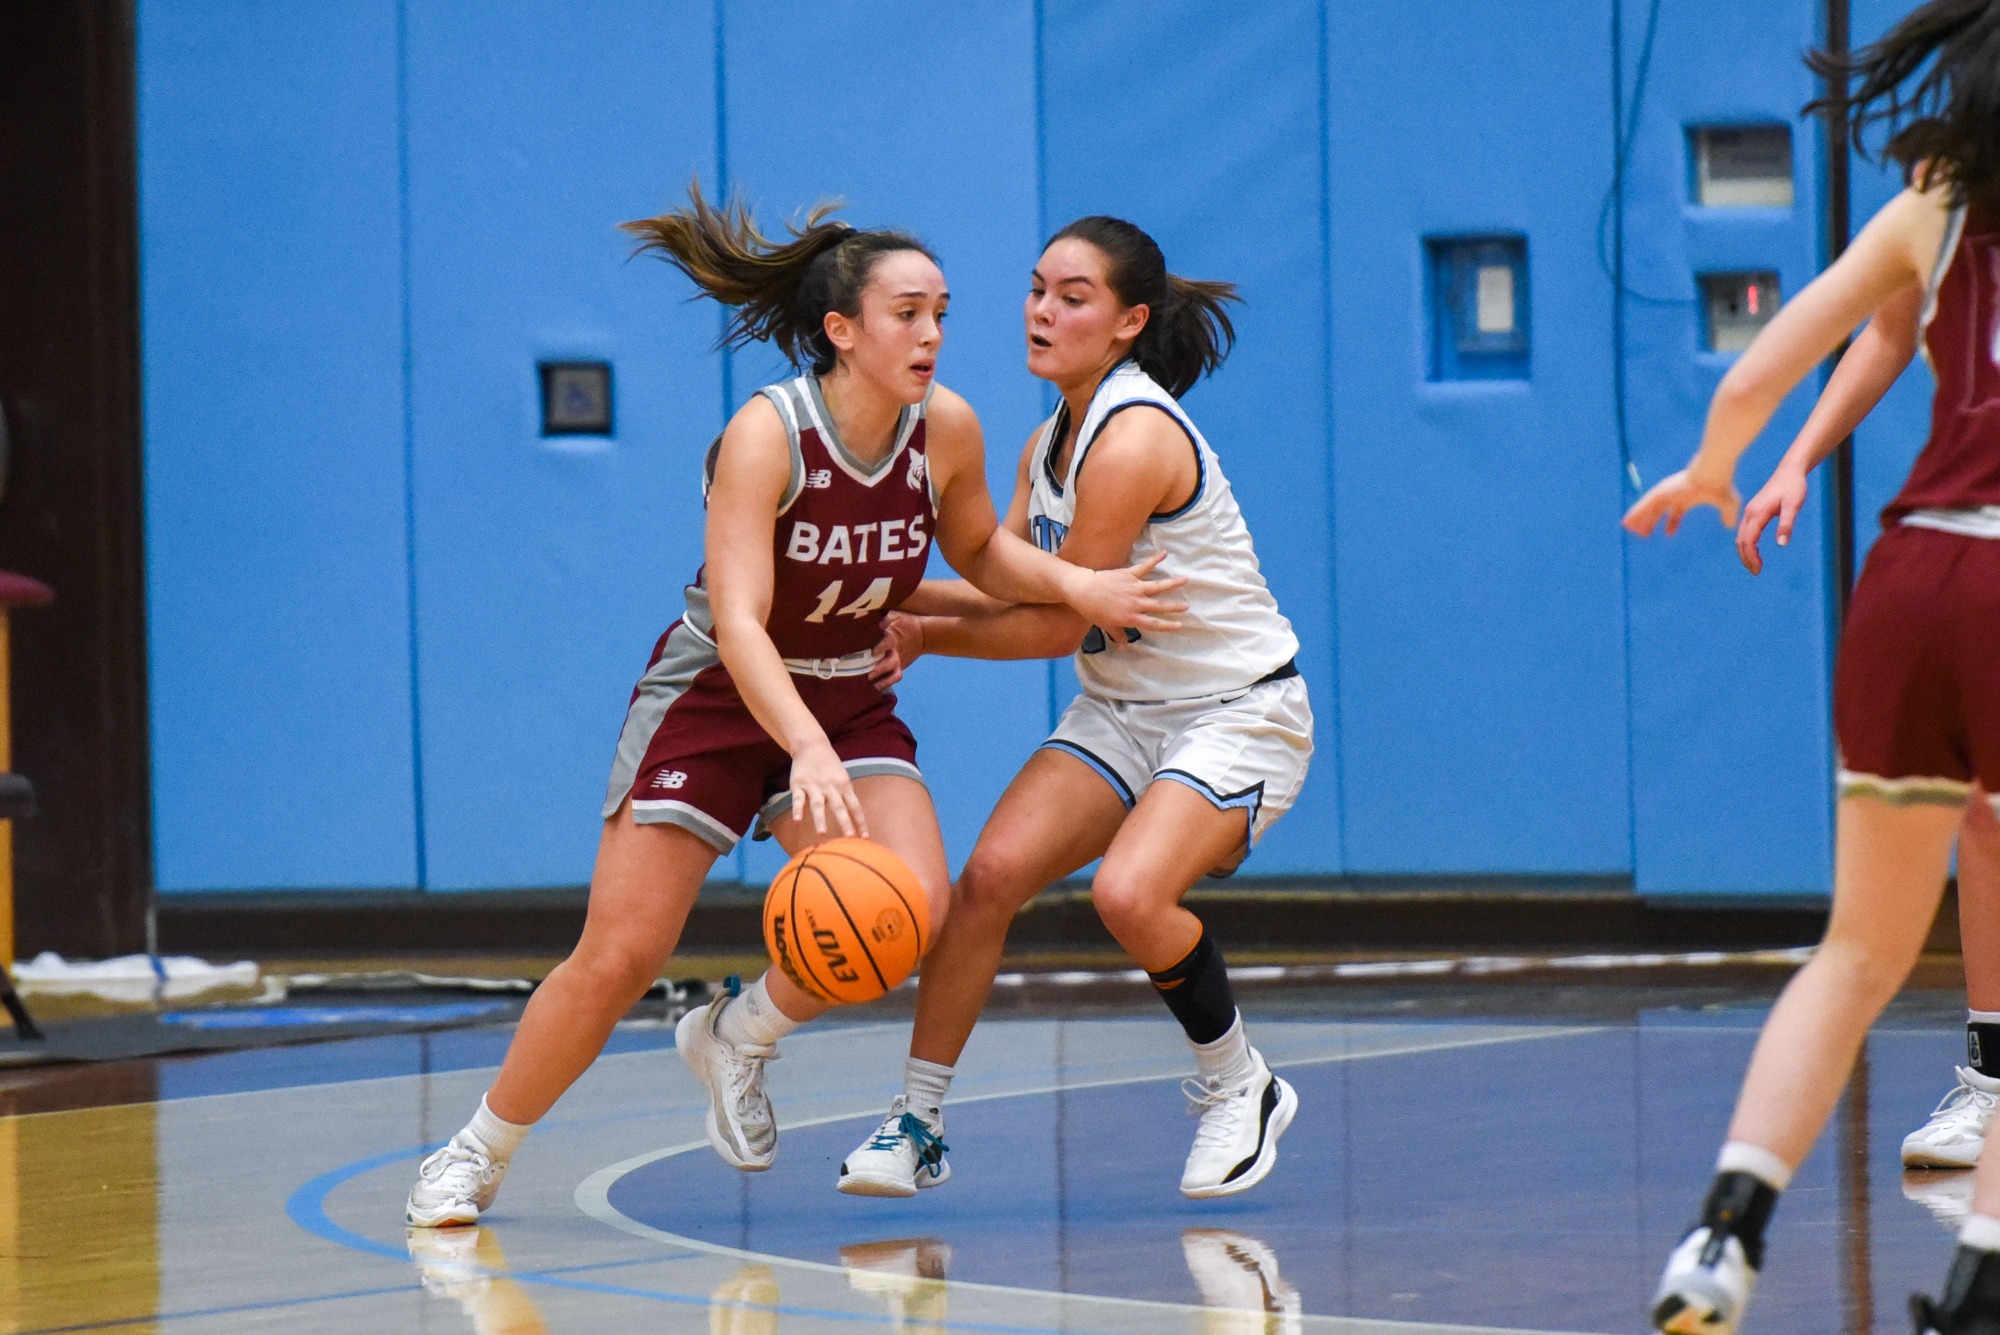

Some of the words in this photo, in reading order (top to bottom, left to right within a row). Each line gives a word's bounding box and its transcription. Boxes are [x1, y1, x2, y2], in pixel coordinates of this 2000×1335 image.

[785, 513, 928, 565] BATES
[803, 577, 894, 623] 14
[813, 929, 860, 983] EVO
